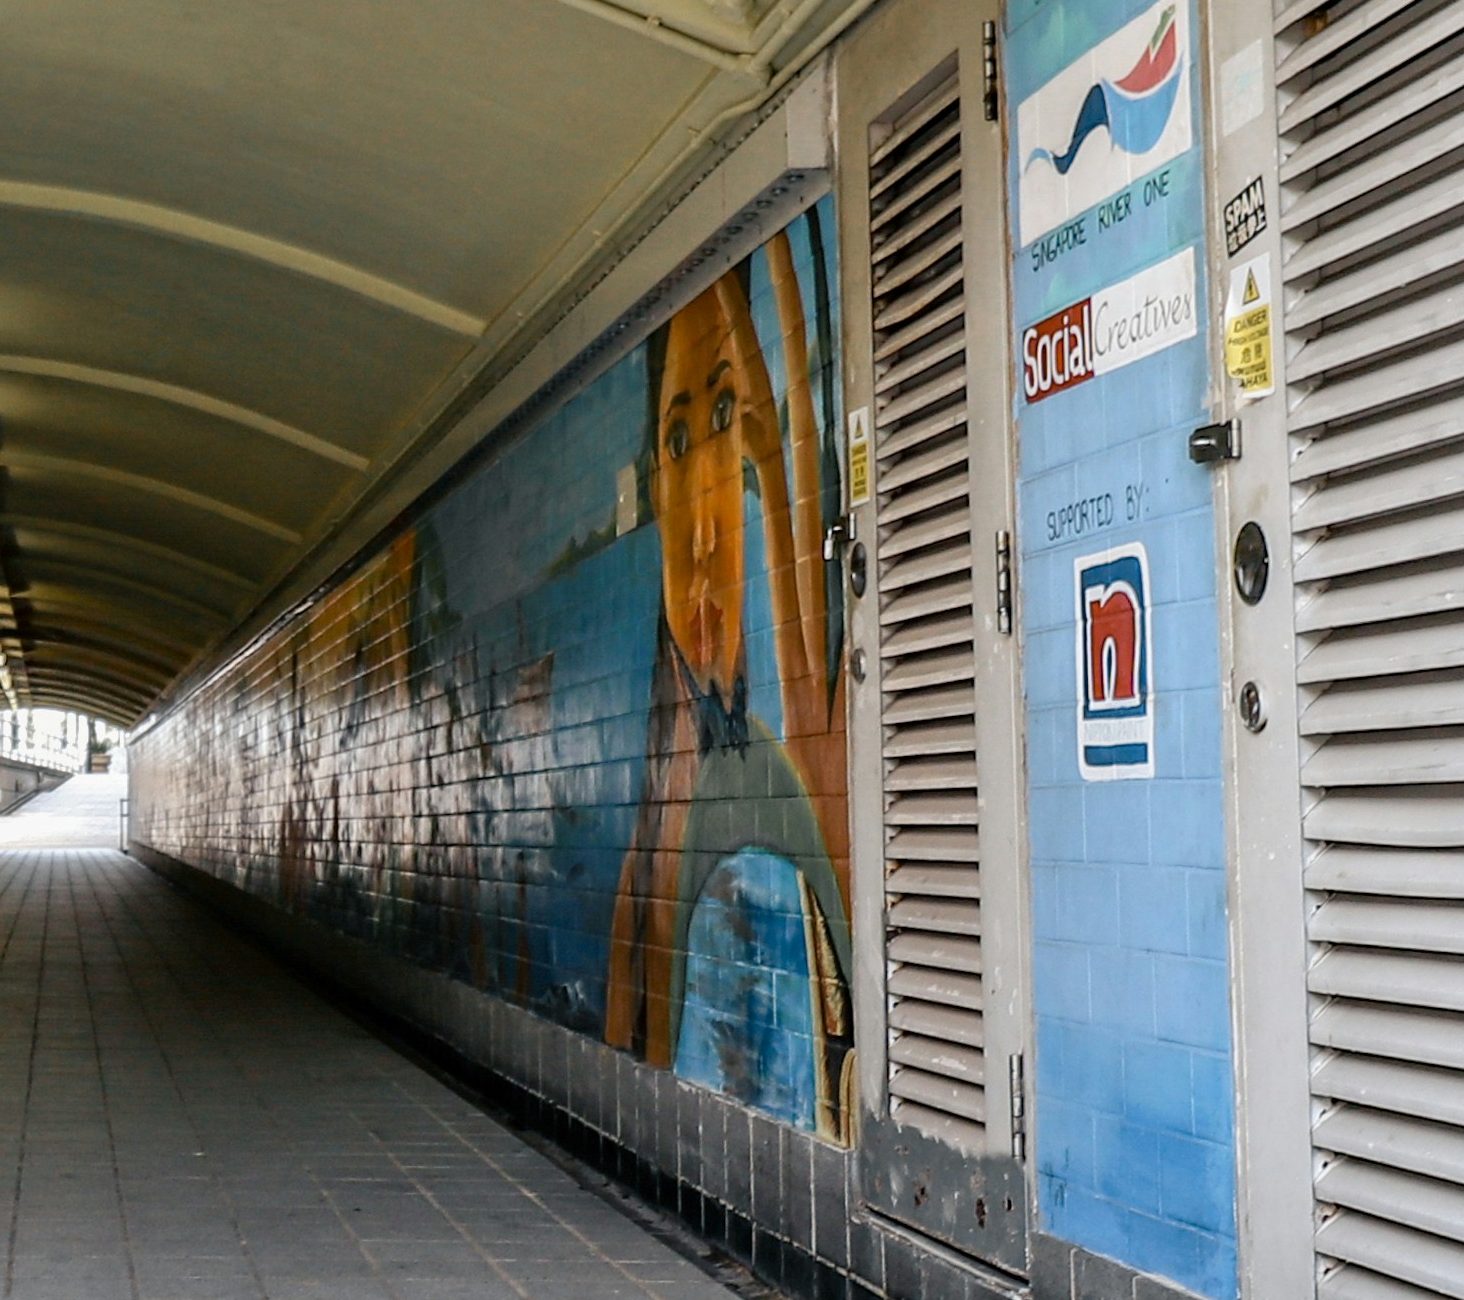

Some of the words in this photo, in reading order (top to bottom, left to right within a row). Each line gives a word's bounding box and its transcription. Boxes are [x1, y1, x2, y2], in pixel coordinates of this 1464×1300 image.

[1031, 216, 1087, 272] SINGAPORE
[1097, 192, 1132, 233] RIVER
[1143, 169, 1171, 207] ONE
[1225, 179, 1265, 233] SPAM
[1025, 303, 1094, 398] Social
[1093, 293, 1192, 357] Creatives
[1233, 308, 1268, 334] DANGER
[1046, 494, 1114, 542] SUPPORTED
